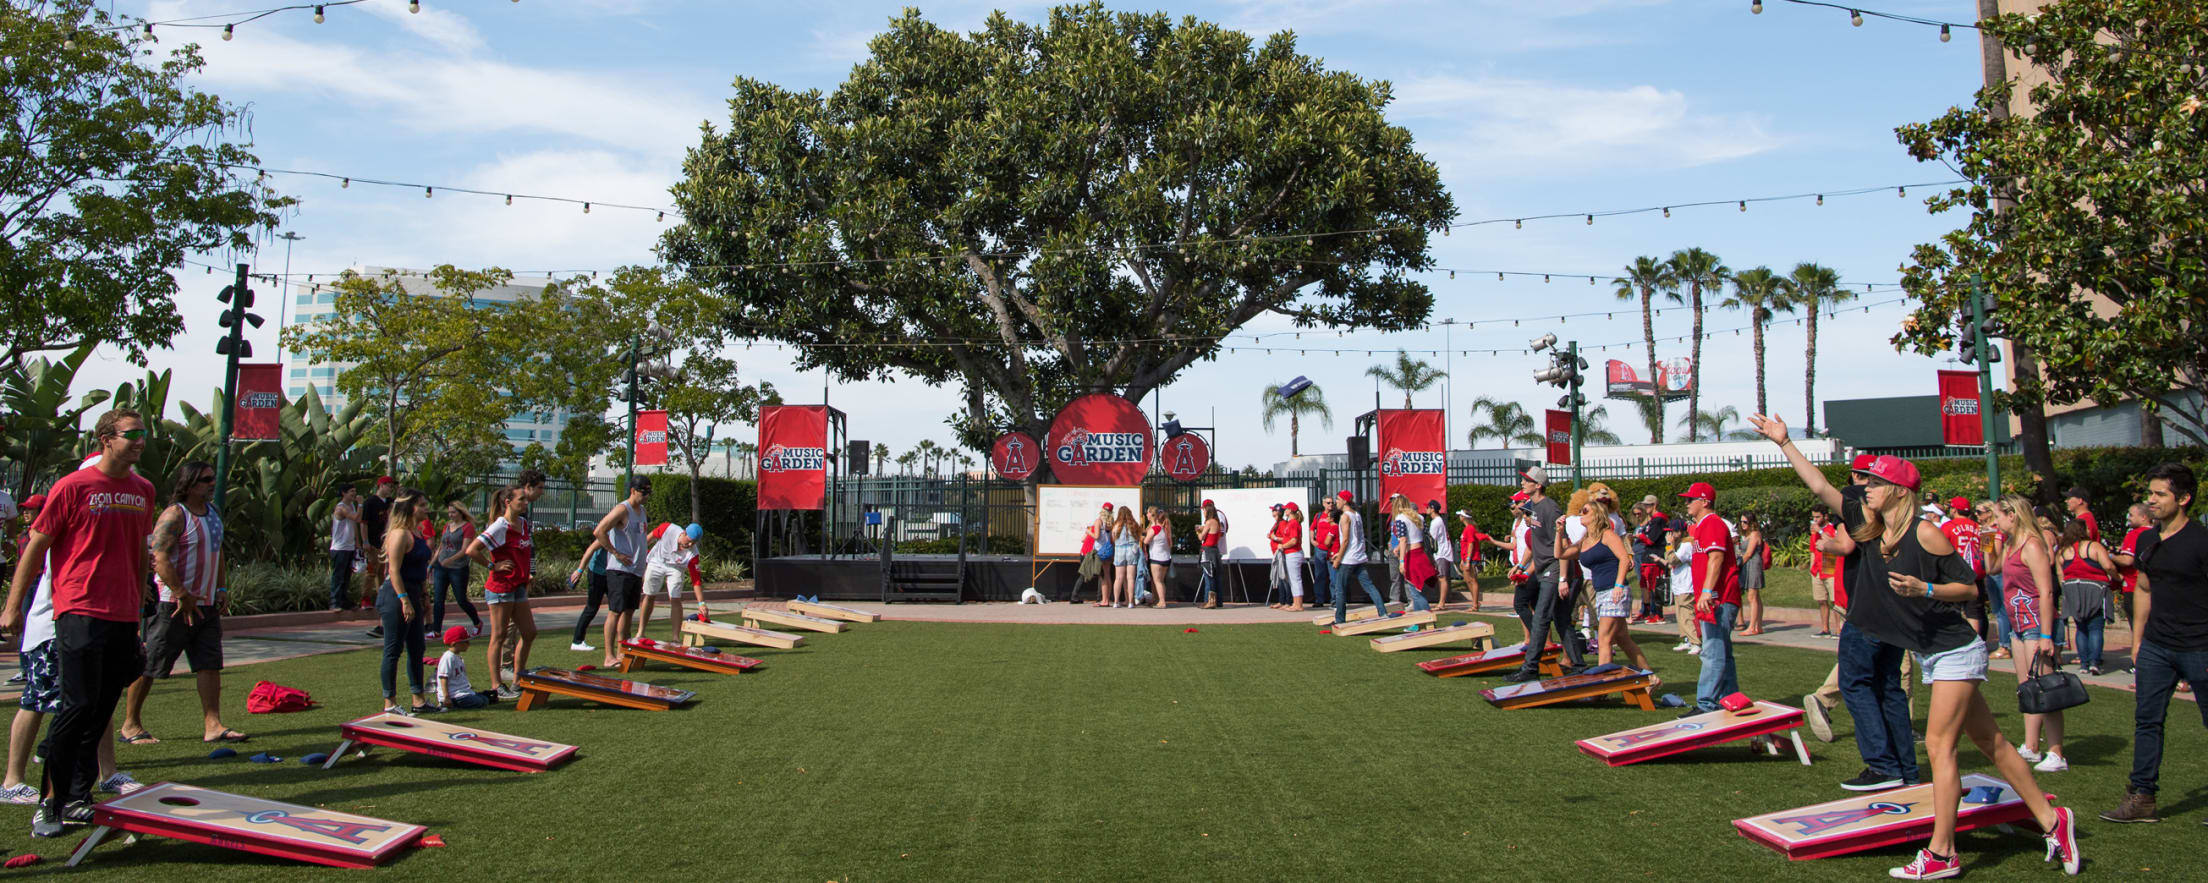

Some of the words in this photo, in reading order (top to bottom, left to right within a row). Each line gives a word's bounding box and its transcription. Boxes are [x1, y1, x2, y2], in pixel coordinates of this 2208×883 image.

[253, 392, 278, 400] MUSIC
[240, 398, 278, 409] GARDEN
[1943, 404, 1978, 415] GARDEN
[1086, 433, 1143, 446] MUSIC
[782, 447, 824, 458] MUSIC
[1057, 441, 1143, 466] GARDEN
[1401, 452, 1443, 462] MUSIC
[761, 455, 824, 472] GARDEN
[1381, 460, 1443, 476] GARDEN
[89, 492, 112, 506] ZION
[114, 492, 146, 508] CANYON
